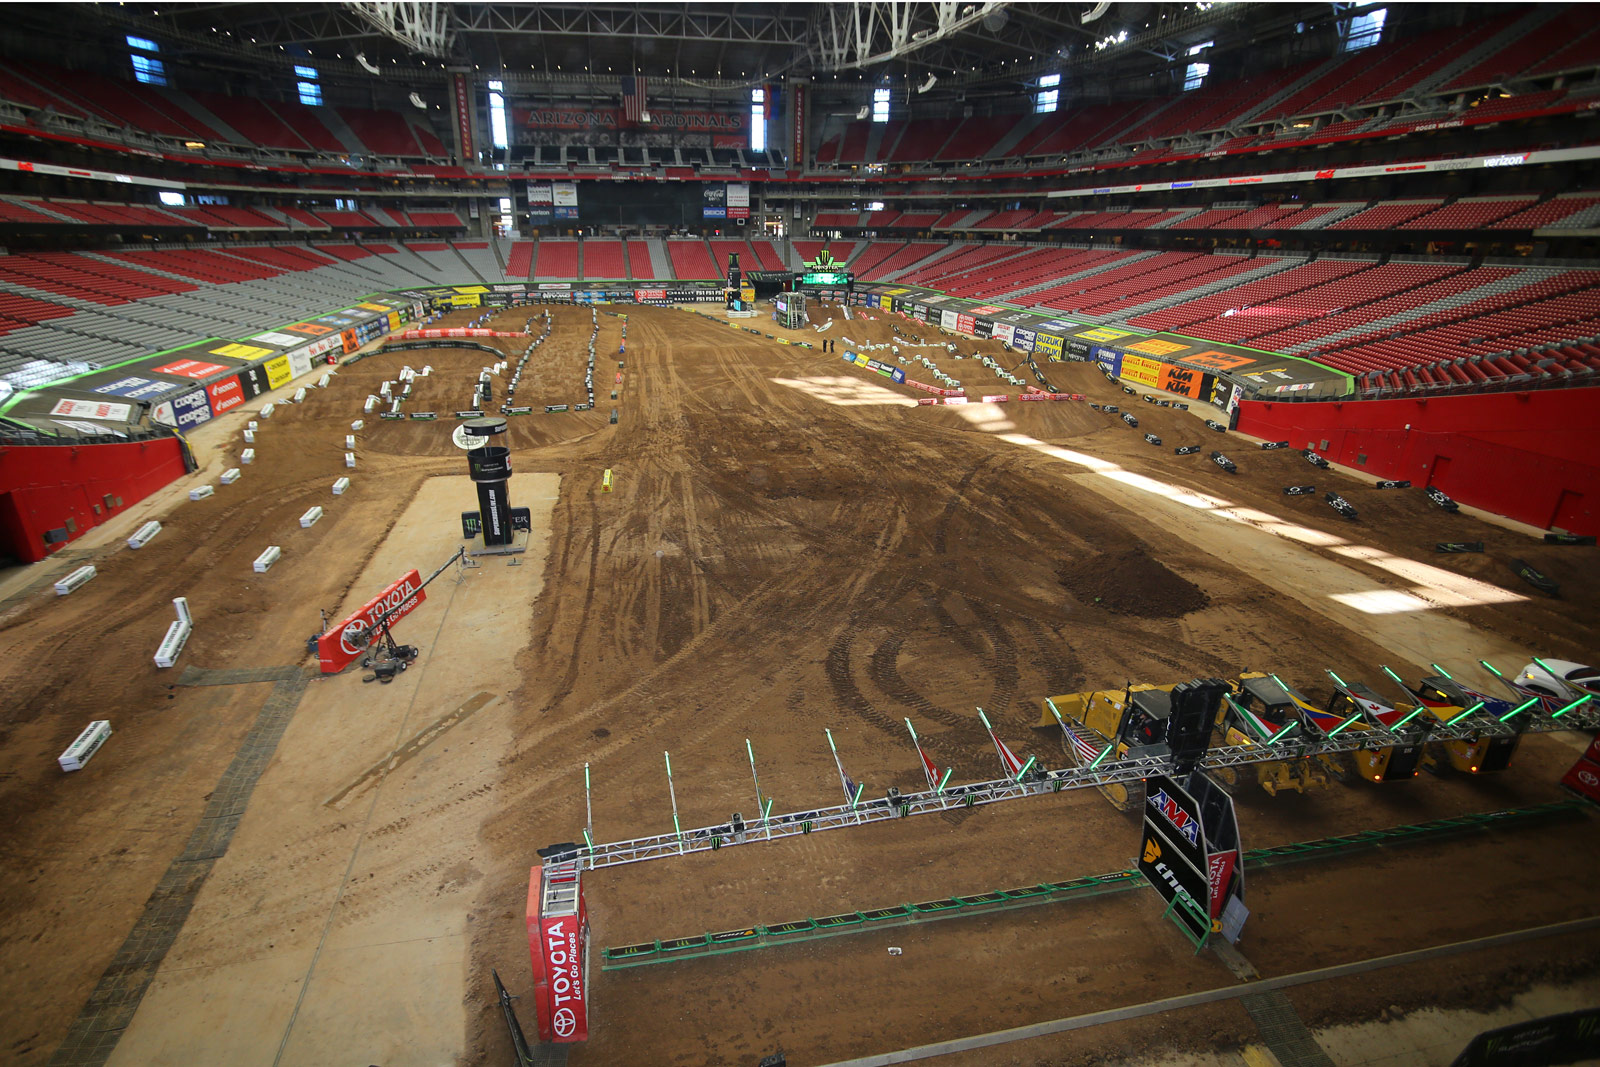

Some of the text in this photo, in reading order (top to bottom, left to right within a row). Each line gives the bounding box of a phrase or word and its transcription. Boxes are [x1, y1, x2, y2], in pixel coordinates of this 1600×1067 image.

[528, 111, 742, 128] ARIZONA ARDINALS
[1415, 120, 1464, 132] ROGER WEHRLI
[1434, 160, 1469, 170] verizon
[1484, 154, 1524, 168] verizon
[1016, 328, 1036, 338] COOPER
[1037, 334, 1062, 346] SUZUKI
[1036, 344, 1060, 357] SUZUKI
[1141, 360, 1161, 370] PIRELLI
[1168, 366, 1193, 382] KTM
[218, 381, 238, 394] HONDA
[1166, 380, 1191, 395] KTM
[174, 389, 206, 408] COOPER
[222, 396, 242, 408] HONDA
[178, 404, 210, 425] COOPER
[367, 580, 414, 622] TOYOTA
[399, 596, 418, 614] Places
[1146, 788, 1202, 847] AMA
[568, 932, 577, 962] Places
[548, 922, 571, 1006] TOYOTA
[570, 963, 578, 978] Go
